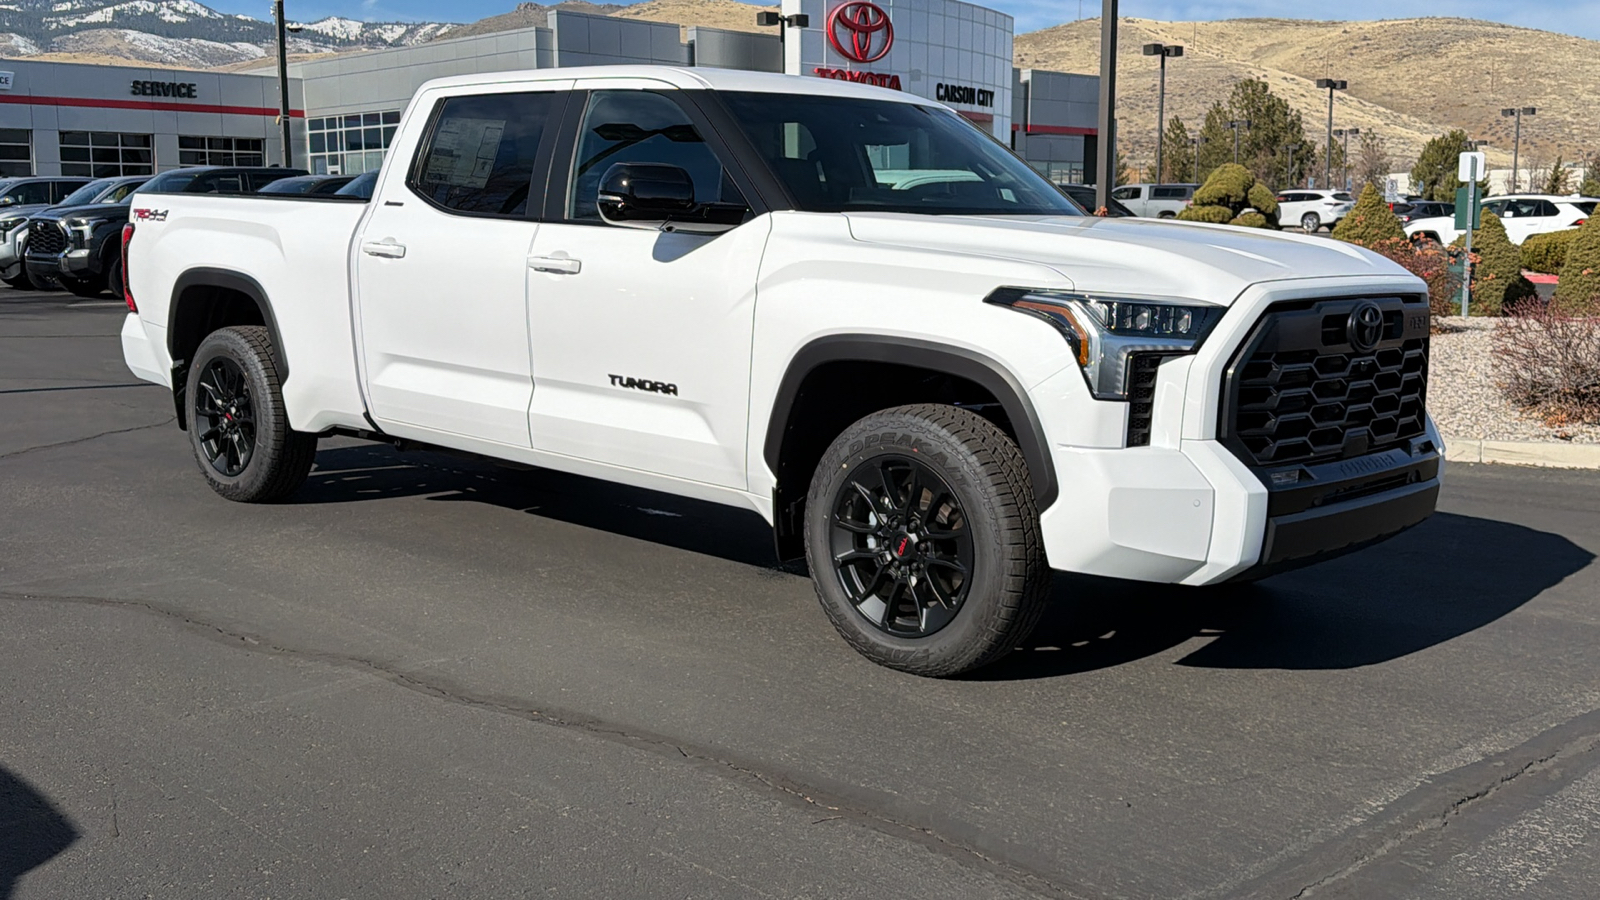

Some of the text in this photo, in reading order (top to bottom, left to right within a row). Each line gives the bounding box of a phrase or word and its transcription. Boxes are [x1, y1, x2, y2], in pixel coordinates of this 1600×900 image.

[131, 80, 197, 98] SERVICE
[814, 67, 902, 91] TOYOTA
[936, 83, 994, 107] CARSON CITY
[607, 373, 678, 397] TUNDRA
[897, 536, 908, 557] TRD
